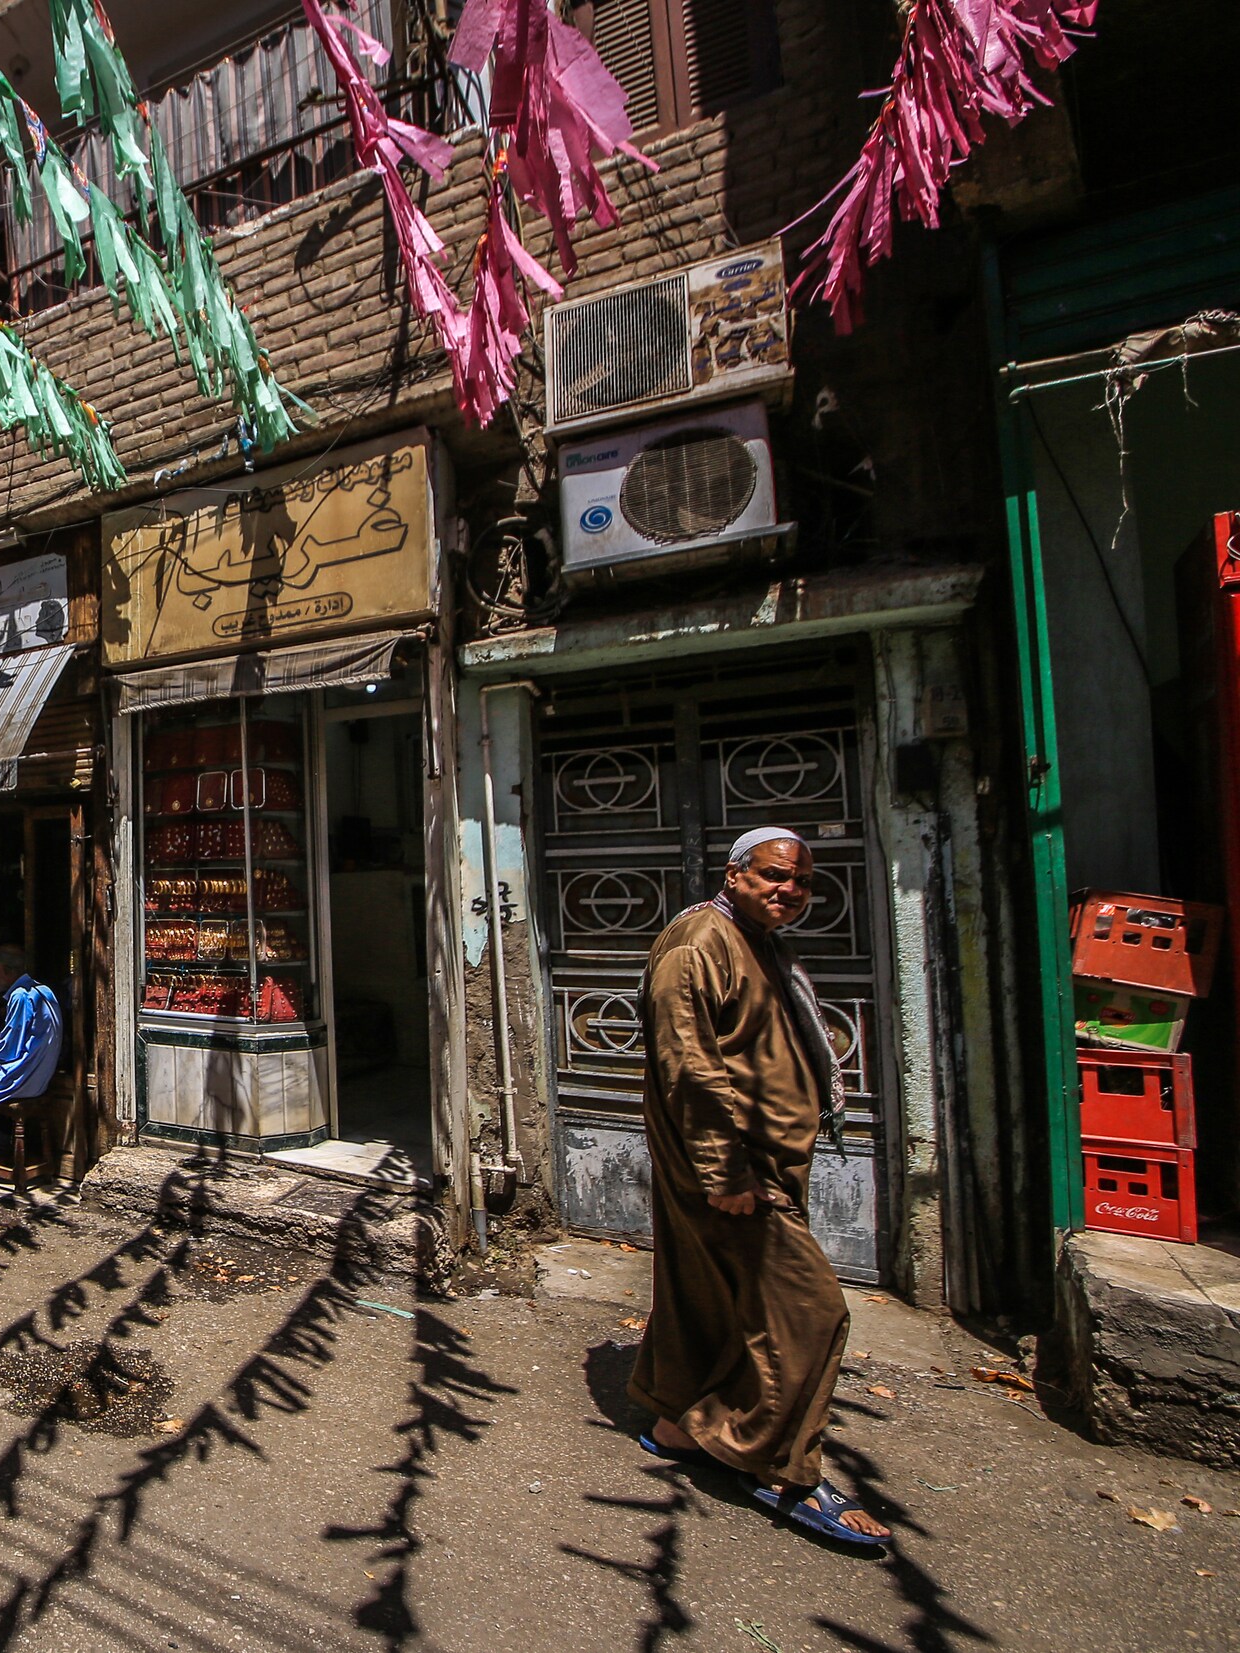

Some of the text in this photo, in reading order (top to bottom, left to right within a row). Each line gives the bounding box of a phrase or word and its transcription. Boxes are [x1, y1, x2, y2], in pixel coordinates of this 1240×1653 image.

[722, 261, 758, 277] Carrier
[566, 450, 618, 468] unionaire
[316, 452, 413, 493] مجوهرات
[176, 487, 409, 611] غريب
[220, 614, 258, 632] غريب
[259, 608, 302, 630] ممدوح
[1095, 1202, 1158, 1221] Coca-Cola
